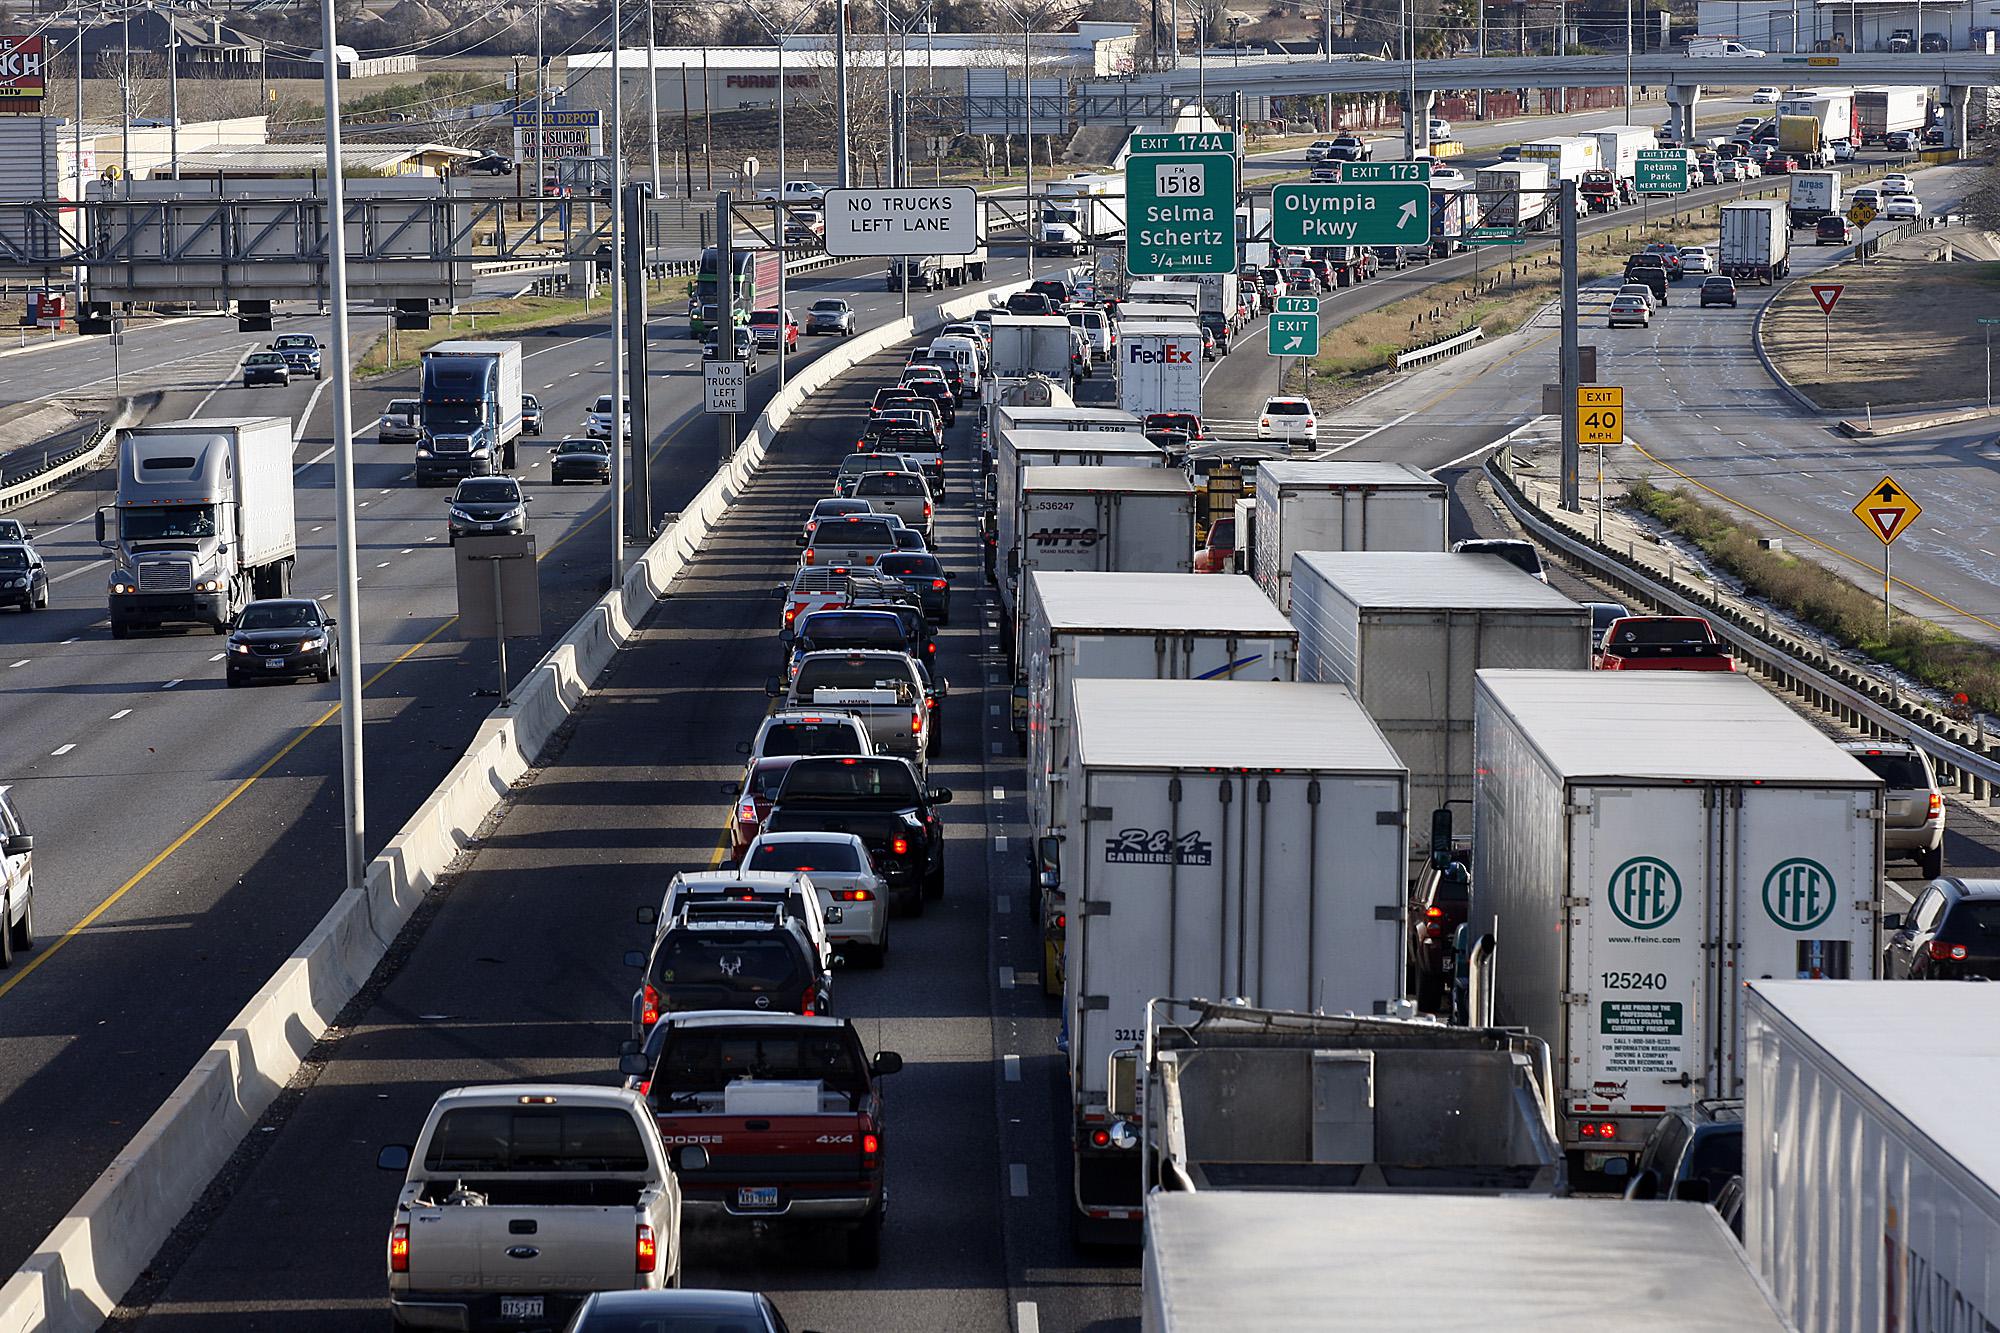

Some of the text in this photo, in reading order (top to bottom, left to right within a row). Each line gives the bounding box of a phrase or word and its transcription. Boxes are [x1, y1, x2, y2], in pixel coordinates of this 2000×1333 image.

[557, 114, 596, 124] DEPOT
[524, 131, 586, 144] OPN SUNDAY
[1141, 136, 1223, 150] EXIT 174A
[524, 146, 587, 158] NON TO 5PM
[1352, 164, 1419, 180] EXIT 173
[1160, 176, 1200, 193] 1518
[1798, 180, 1824, 189] Airgas
[848, 197, 952, 211] NO TRUCKS
[1285, 194, 1376, 215] Olympia
[1148, 205, 1214, 222] Selma
[852, 218, 949, 232] LEFT LANE
[1303, 219, 1357, 240] Pkwy
[1140, 229, 1222, 246] Schertz
[1151, 254, 1212, 268] 3/4 MILE
[1286, 299, 1310, 311] 173
[1278, 321, 1308, 332] EXIT
[1131, 345, 1193, 364] FedEx
[1587, 393, 1612, 402] EXIT
[1585, 412, 1616, 428] 40
[1040, 502, 1075, 510] 536247
[1036, 528, 1098, 547] MTS
[1120, 830, 1200, 852] R & A
[1183, 854, 1210, 864] INC.
[1624, 865, 1666, 921] FFE
[1778, 866, 1820, 922] FFE
[1608, 936, 1681, 944] www.ffeinc.com
[1601, 973, 1667, 990] 125240
[663, 1135, 723, 1144] DODGE
[450, 1274, 598, 1287] SUPER DUTY
